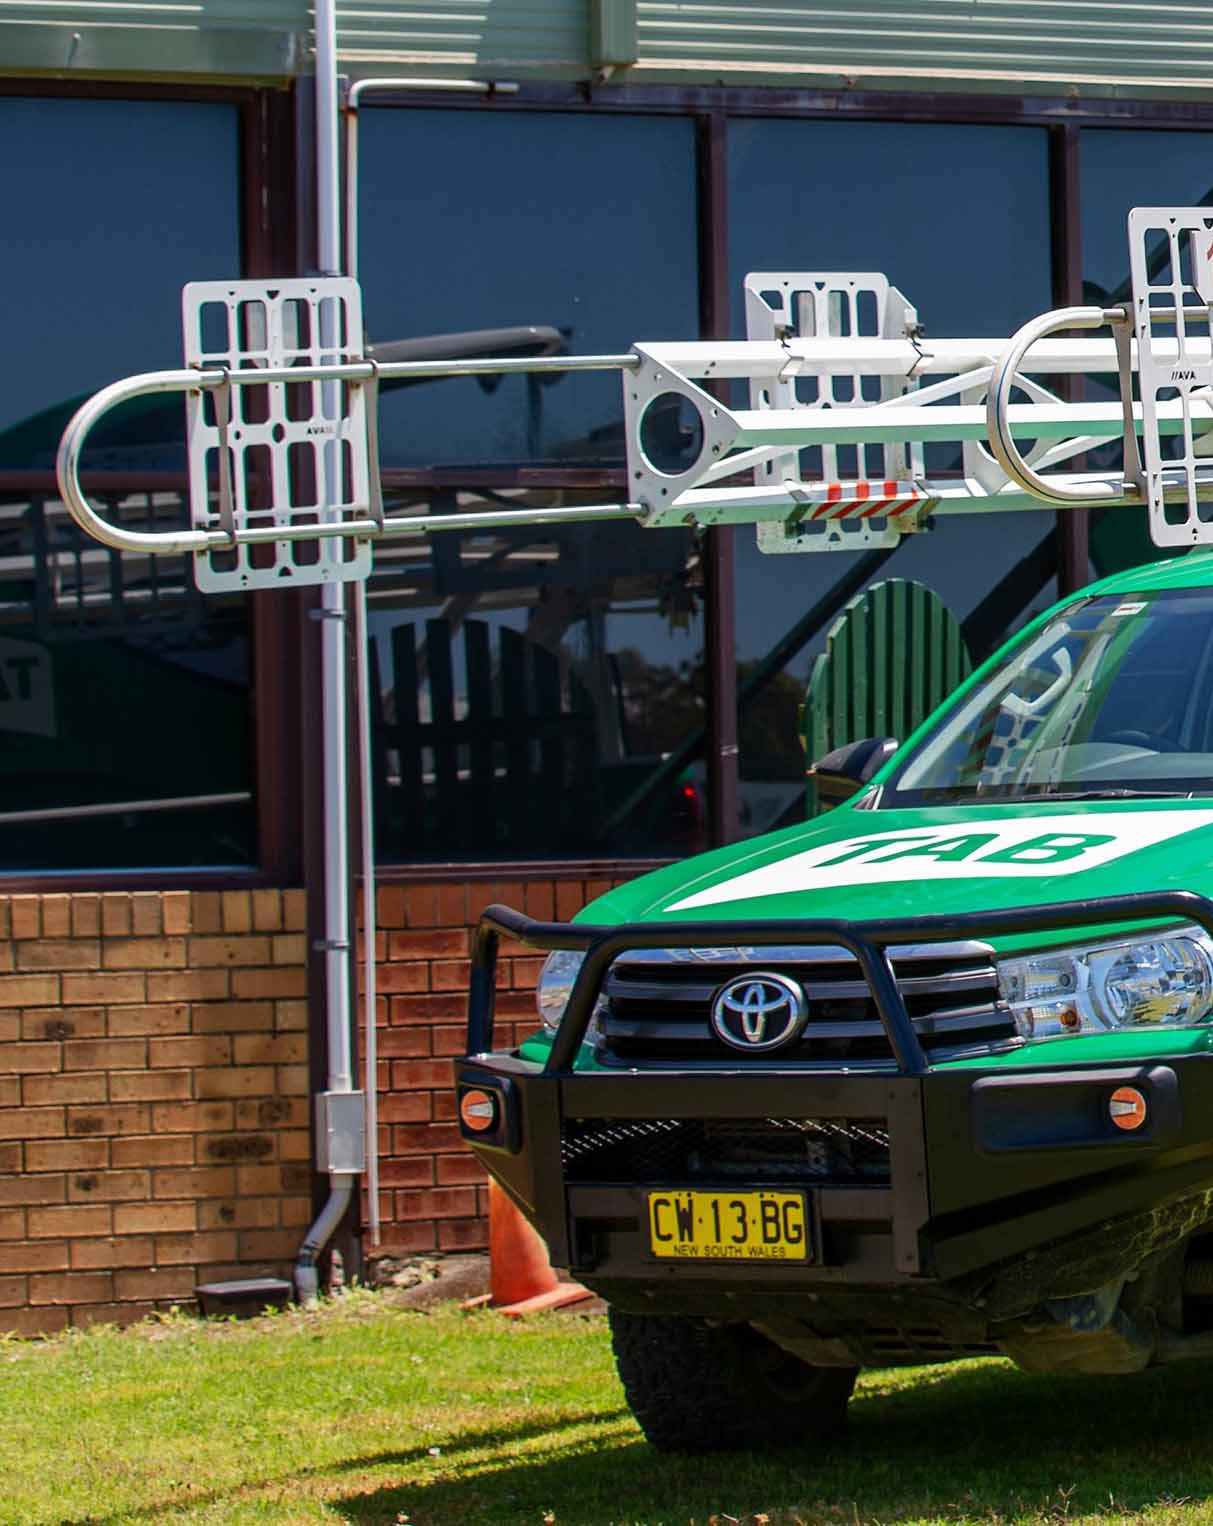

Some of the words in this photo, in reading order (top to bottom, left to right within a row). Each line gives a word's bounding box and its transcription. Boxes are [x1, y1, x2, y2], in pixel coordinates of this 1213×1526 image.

[809, 833, 1118, 869] TAB
[674, 1244, 699, 1257] NEW
[703, 1246, 742, 1257] SOUTH
[748, 1247, 786, 1258] WALES
